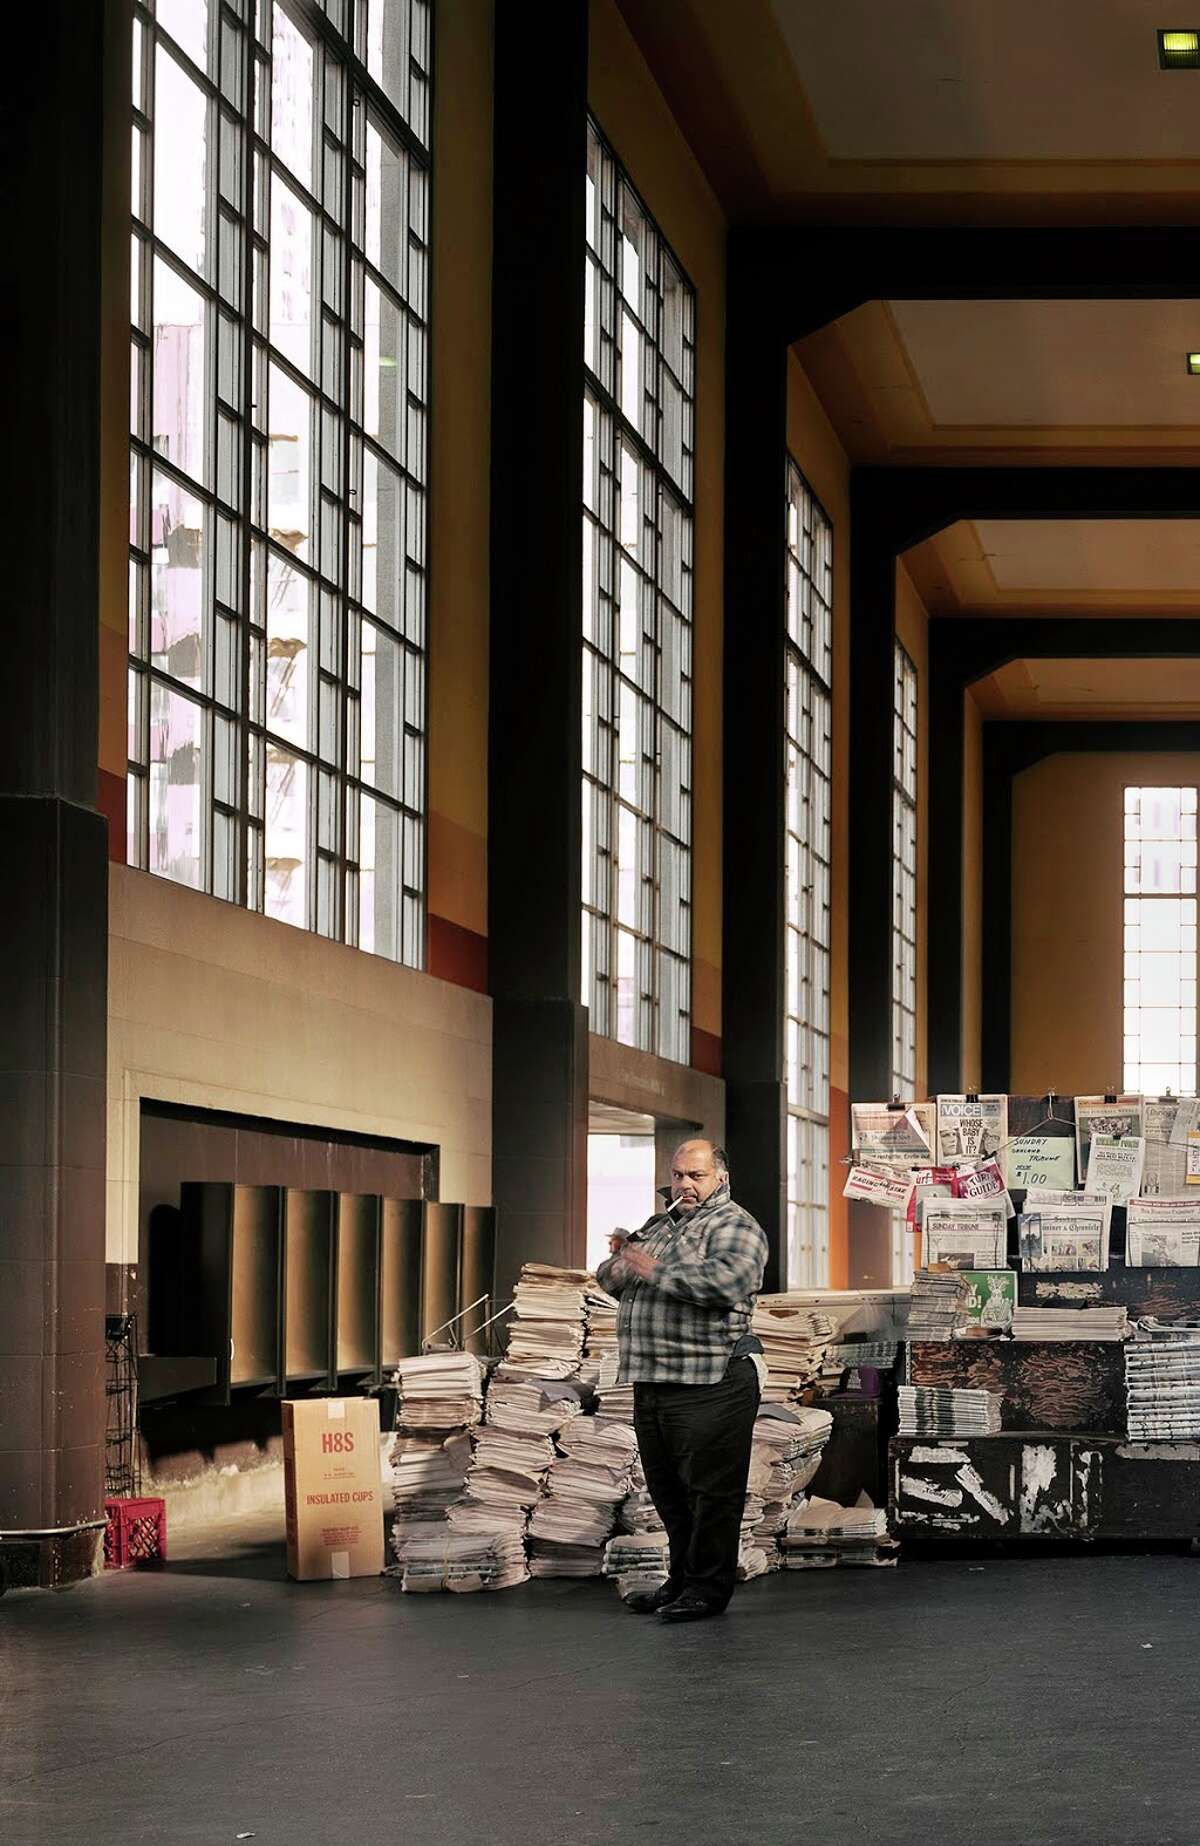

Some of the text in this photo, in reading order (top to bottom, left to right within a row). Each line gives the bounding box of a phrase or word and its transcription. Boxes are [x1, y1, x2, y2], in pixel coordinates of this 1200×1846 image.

[943, 1104, 982, 1117] VOICE
[960, 1119, 984, 1128] WHOSE
[963, 1128, 980, 1137] BABY
[967, 1137, 975, 1145] IS
[1013, 1138, 1048, 1146] SUNDAY
[306, 1490, 375, 1505] INSULATED CUPS
